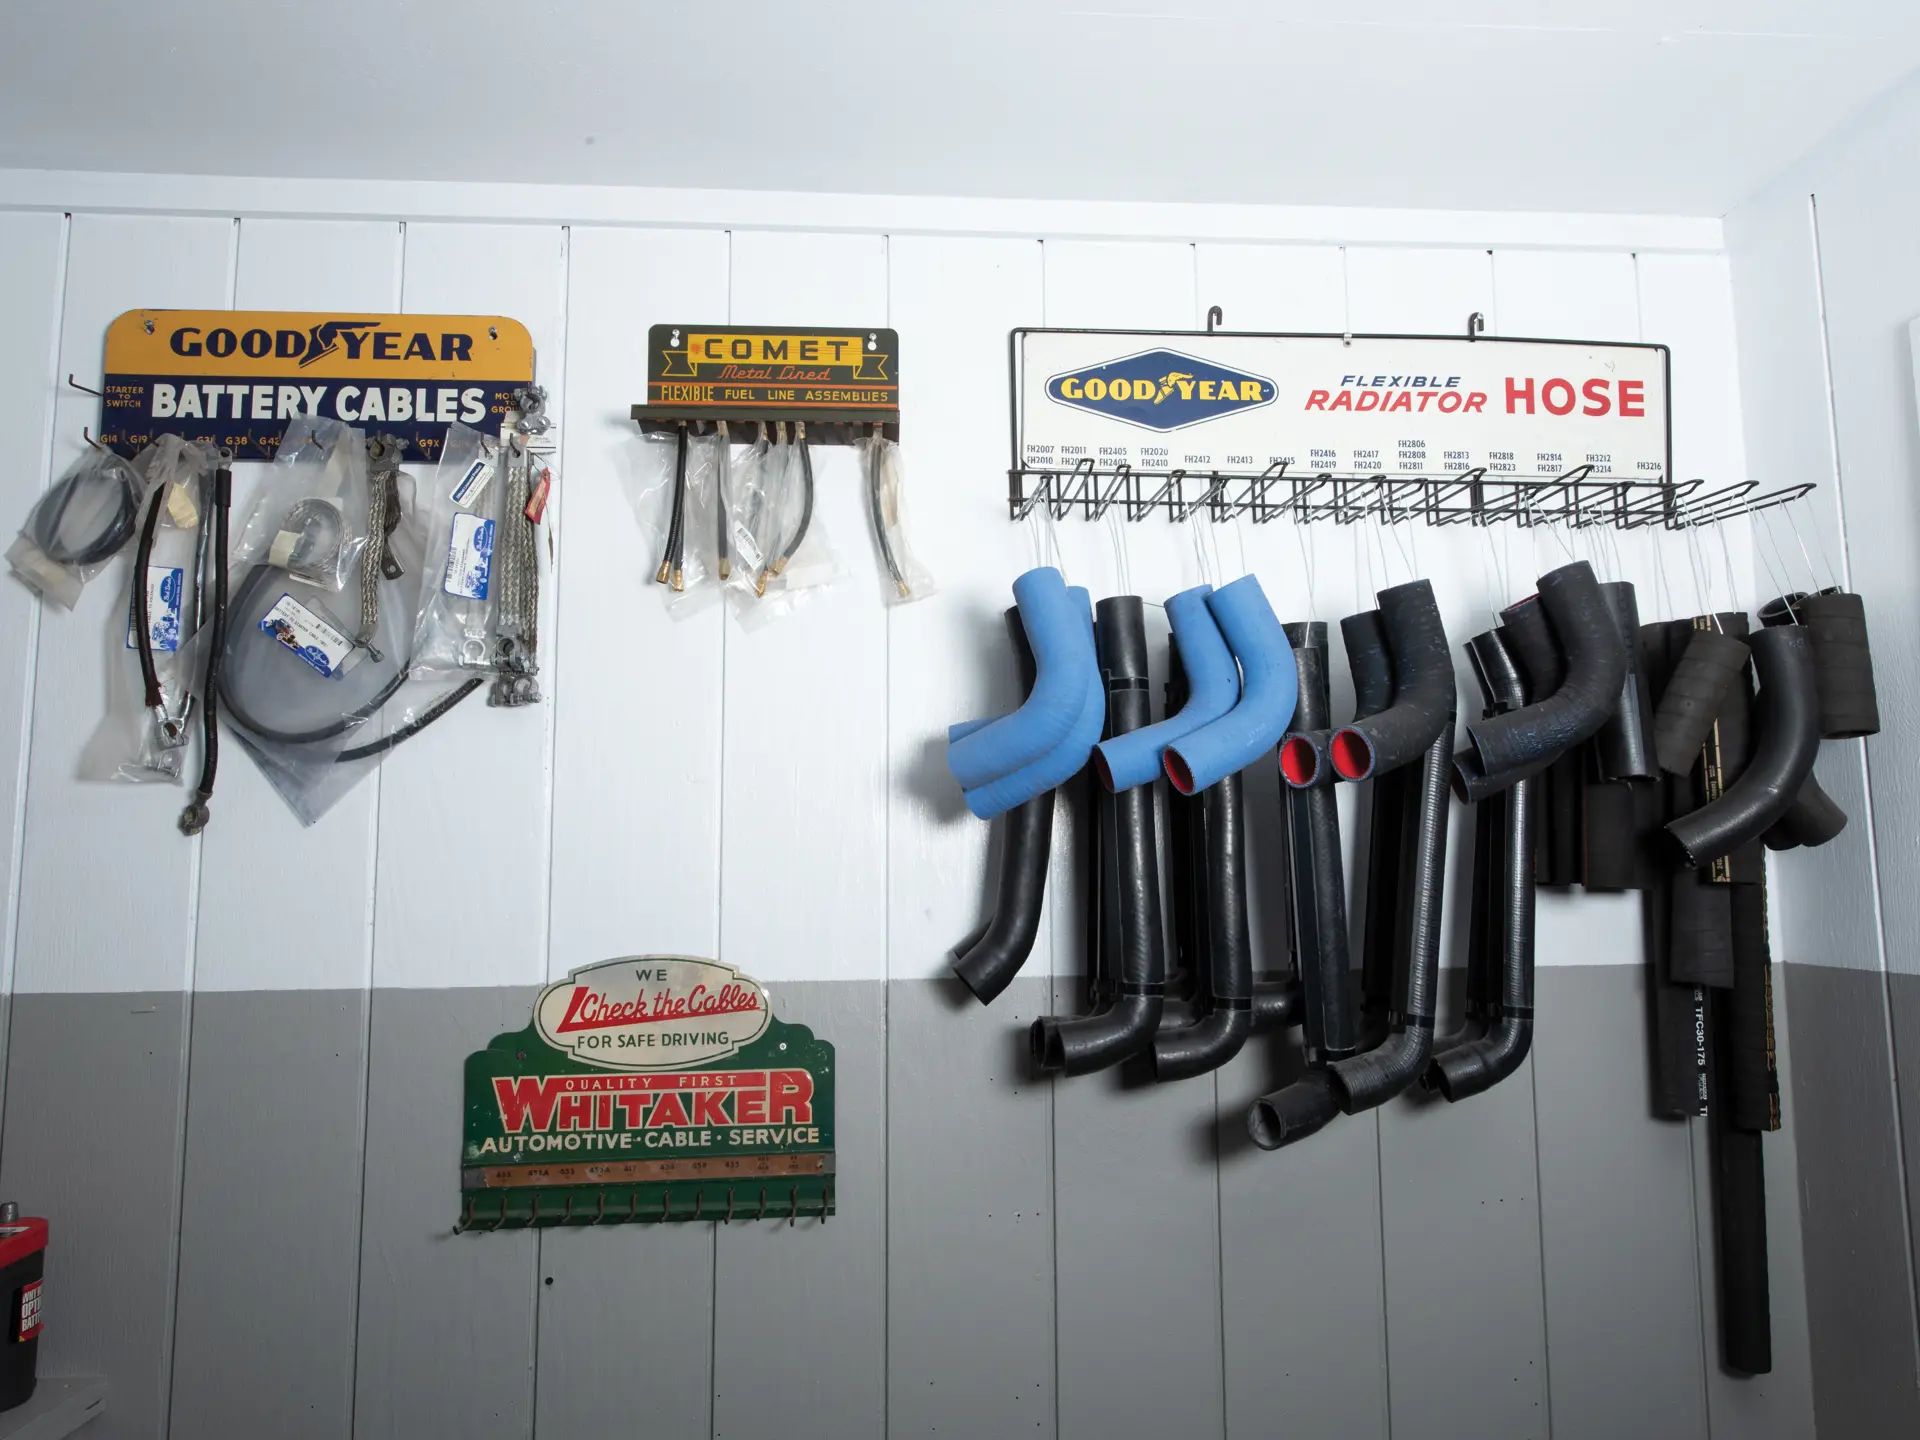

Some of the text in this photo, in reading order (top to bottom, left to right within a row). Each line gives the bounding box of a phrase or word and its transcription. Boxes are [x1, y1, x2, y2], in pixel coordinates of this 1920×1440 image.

[704, 338, 849, 361] COMET
[717, 364, 831, 381] Metal Lined
[1340, 375, 1461, 388] FLEXIBLE
[105, 385, 144, 394] STARTER
[495, 392, 515, 401] MOT
[661, 385, 888, 402] FLEXIBLE FUEL LINE ASSEMBLIES
[106, 400, 141, 408] SWITCH
[151, 383, 486, 424] BATTERY CABLES
[1304, 377, 1645, 417] RADIATOR HOSE
[100, 434, 118, 443] G14
[130, 435, 148, 443] G19
[226, 436, 247, 445] G38
[418, 438, 440, 447] G9X
[1398, 440, 1426, 448] FH2806
[1027, 445, 1054, 453] FH2007
[1061, 446, 1087, 454] FH2011
[1310, 449, 1336, 458] FH2416
[1354, 450, 1379, 458] FH2417
[1398, 451, 1426, 459] FH2808
[1443, 451, 1469, 459] FH2813
[1489, 452, 1514, 460] FH2818
[1586, 454, 1611, 462] FH3212
[1027, 456, 1053, 464] FH2010
[1142, 459, 1168, 467] FH2410
[1184, 455, 1211, 464] FH2412
[1227, 456, 1253, 464] FH2413
[1310, 460, 1662, 473] FH2419 FH2420 FH2811 FH2816 FH2823 FH2817 H3214 FH3216
[635, 969, 667, 982] WE
[580, 984, 758, 1022] Check the Cables
[577, 1031, 729, 1049] FOR SAFE DRIVING
[1695, 1006, 1706, 1066] TFC30-175
[565, 1075, 737, 1091] QUALITY FIRST
[491, 1068, 814, 1134] WHITAKER
[480, 1127, 820, 1154] AUTOMOTIVE CABLE SERVICE
